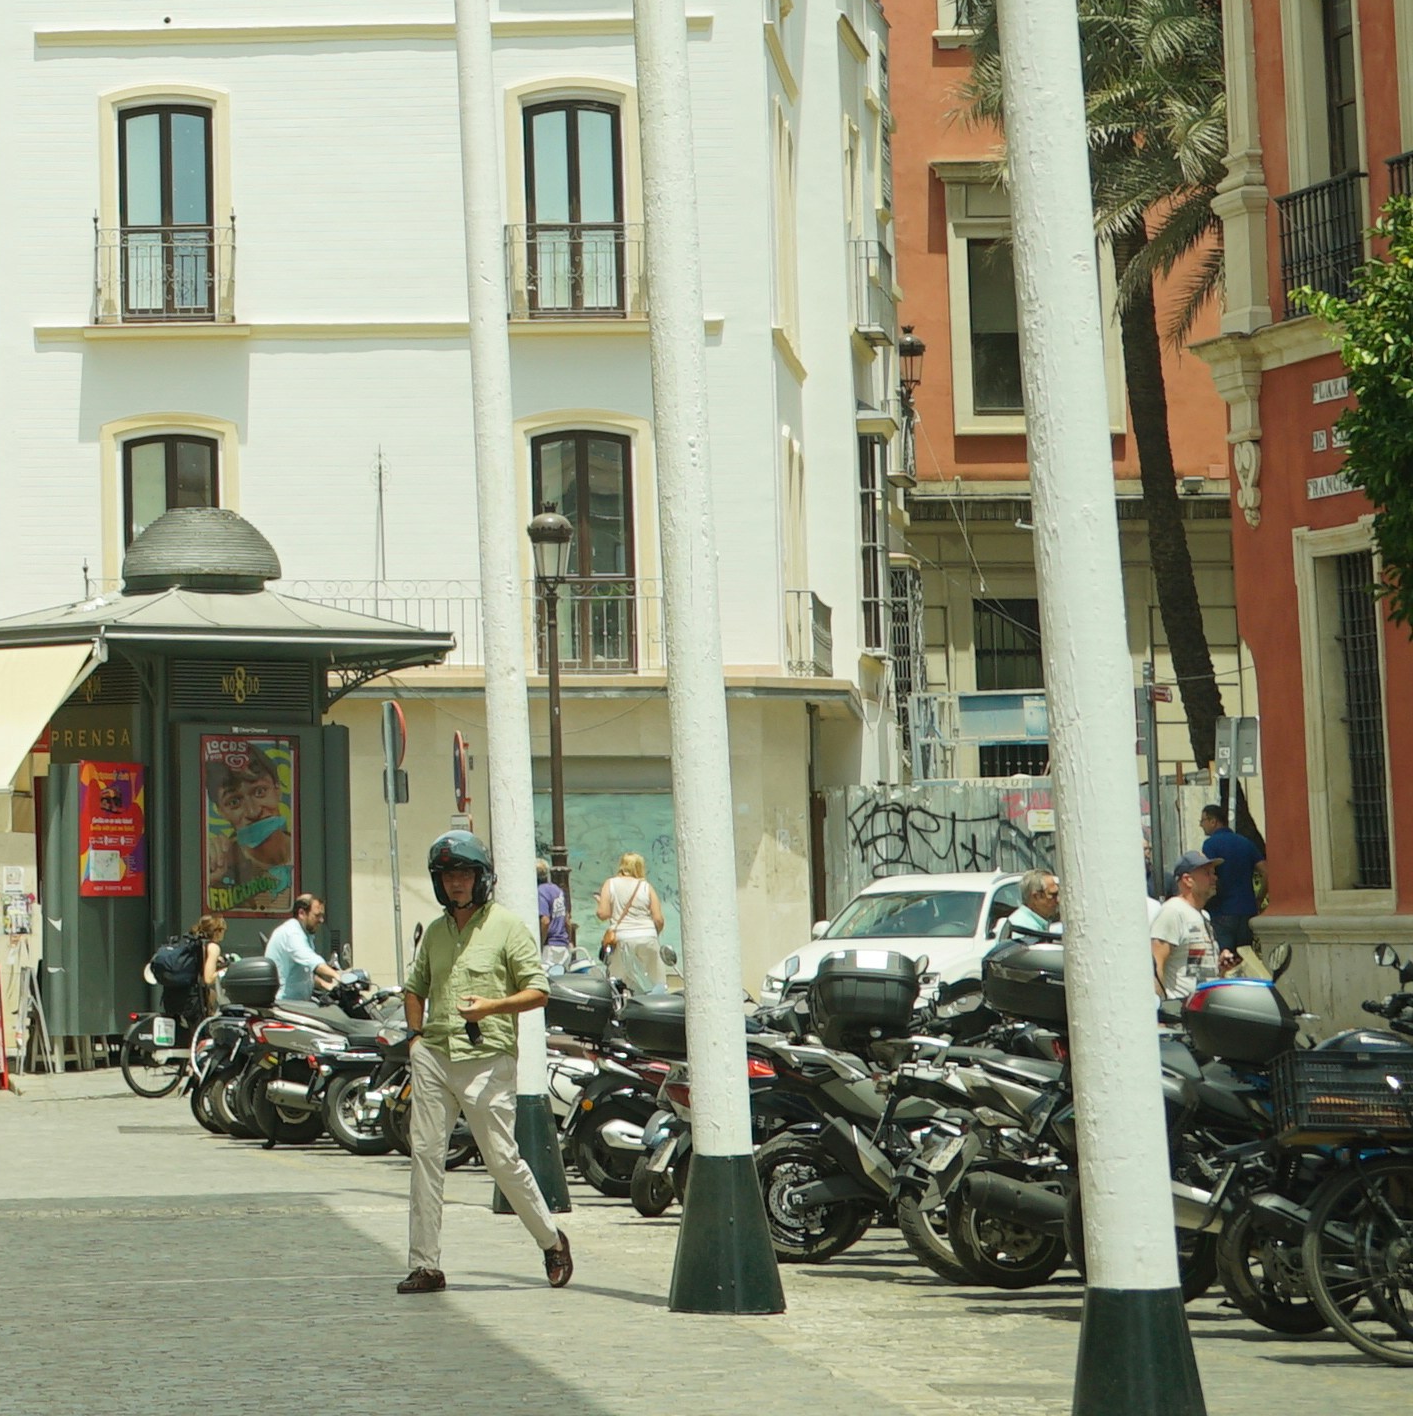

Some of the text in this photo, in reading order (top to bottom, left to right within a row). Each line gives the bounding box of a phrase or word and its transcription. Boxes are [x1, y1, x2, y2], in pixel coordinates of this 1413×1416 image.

[1313, 378, 1347, 400] PLAZA
[1313, 432, 1325, 450] DE
[51, 728, 130, 747] PRENSA
